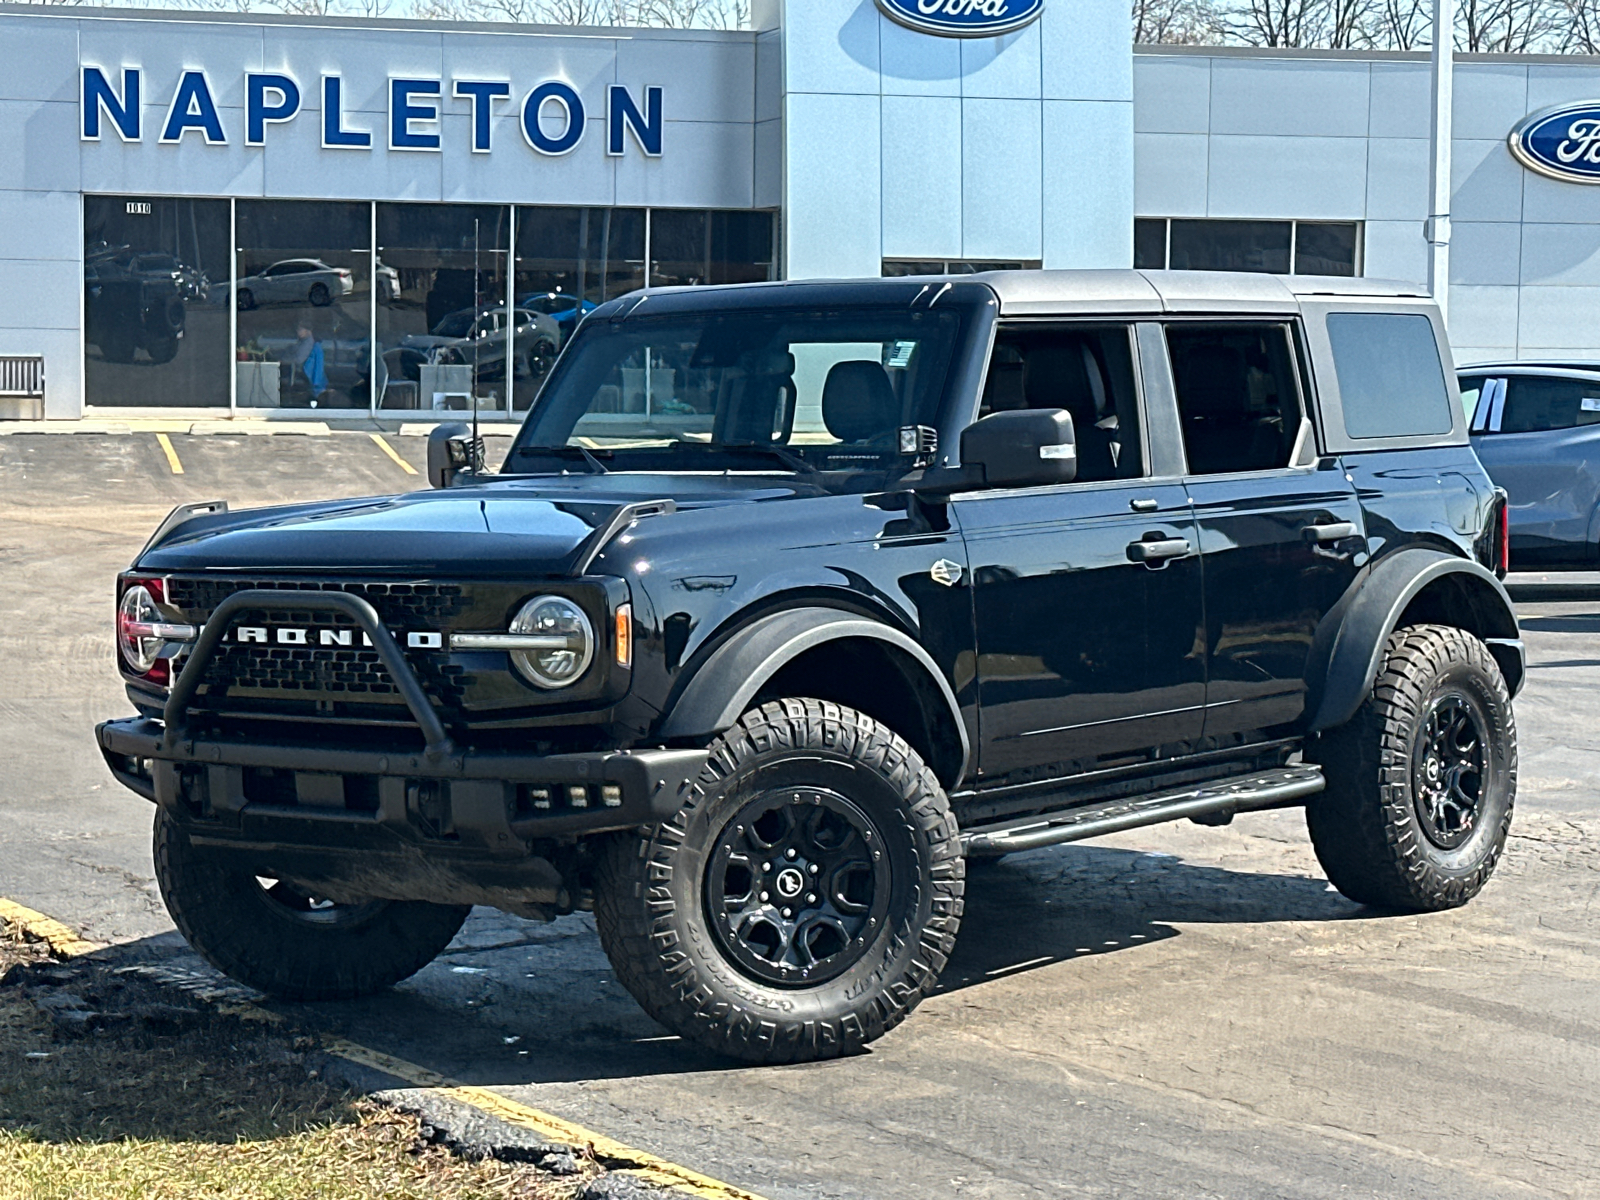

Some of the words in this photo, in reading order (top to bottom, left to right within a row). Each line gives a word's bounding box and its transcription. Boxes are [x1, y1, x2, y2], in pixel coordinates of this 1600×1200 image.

[81, 65, 664, 157] NAPLETON
[1556, 119, 1600, 163] Fo
[126, 202, 151, 214] 1010
[200, 625, 442, 648] RONO
